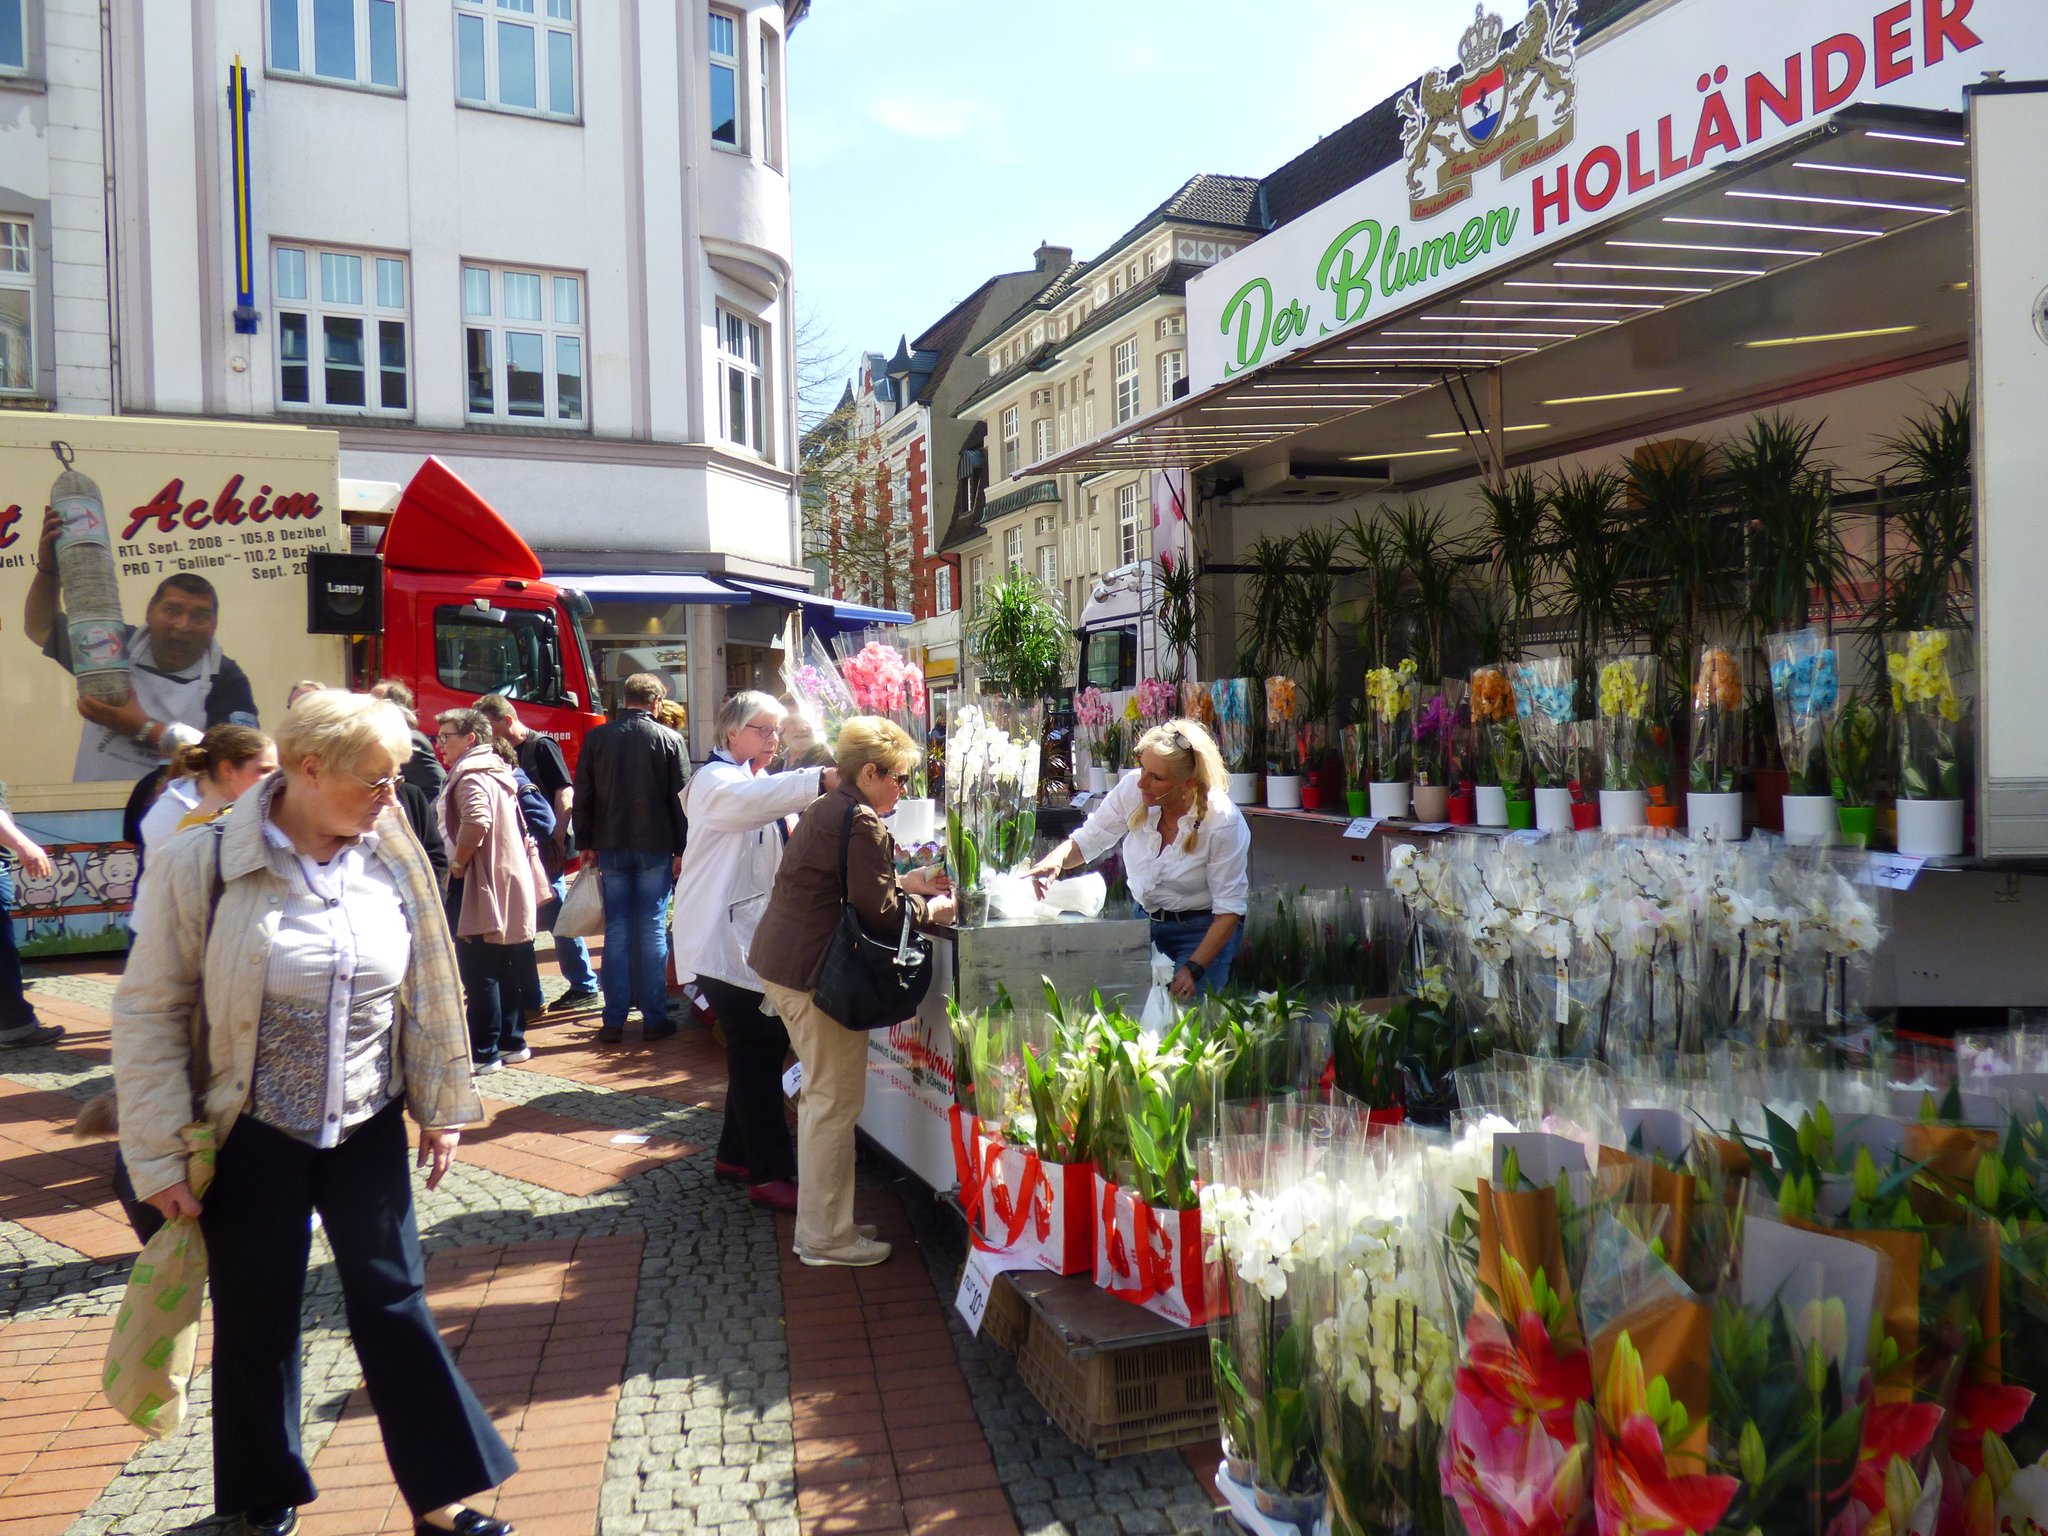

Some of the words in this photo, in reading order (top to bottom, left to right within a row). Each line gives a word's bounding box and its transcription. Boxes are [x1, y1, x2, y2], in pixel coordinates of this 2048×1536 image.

[1450, 161, 1474, 177] Fam.
[1476, 132, 1521, 168] Saarloos
[1517, 133, 1565, 169] Holland
[1220, 277, 1310, 378] Der
[1315, 205, 1521, 336] Blumen
[1532, 0, 1984, 236] HOLLÄNDER
[1413, 187, 1465, 218] Amsterdam
[121, 473, 323, 541] Achim
[118, 544, 143, 558] RTL
[148, 540, 184, 556] Sept.
[189, 536, 223, 551] 2008
[280, 525, 327, 541] Dezibel
[123, 562, 150, 577] PRO
[157, 560, 164, 573] 7
[252, 565, 288, 581] Sept.
[327, 582, 365, 597] Laney
[923, 1096, 948, 1122] HAMBU
